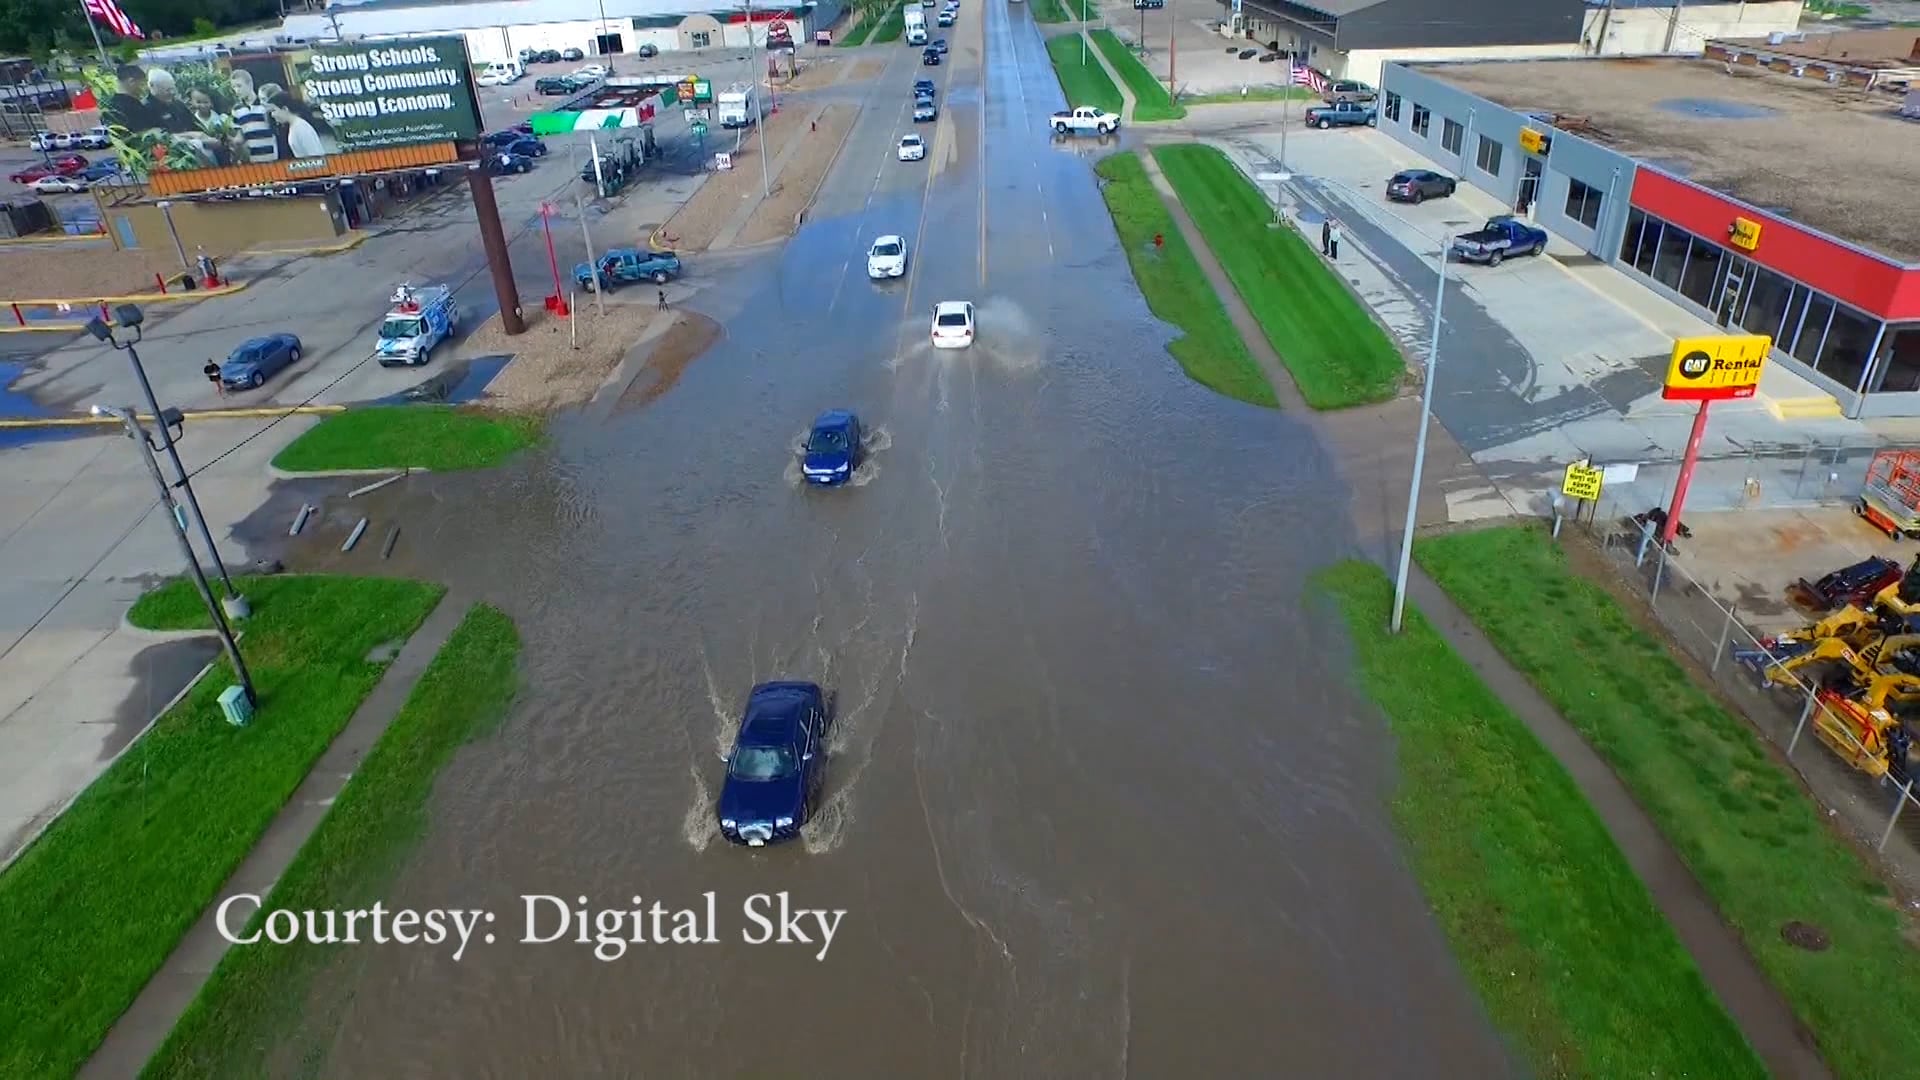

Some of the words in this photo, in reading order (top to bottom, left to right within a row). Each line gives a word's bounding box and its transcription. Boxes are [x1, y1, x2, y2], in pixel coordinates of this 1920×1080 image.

[311, 53, 369, 73] Strong
[369, 45, 441, 66] Schools.
[304, 78, 363, 98] Strong
[363, 67, 461, 92] Community.
[320, 101, 377, 121] Strong
[377, 92, 455, 114] Economy.
[289, 159, 324, 170] LAMAR
[1684, 359, 1707, 372] CAT
[1713, 356, 1763, 370] Rental
